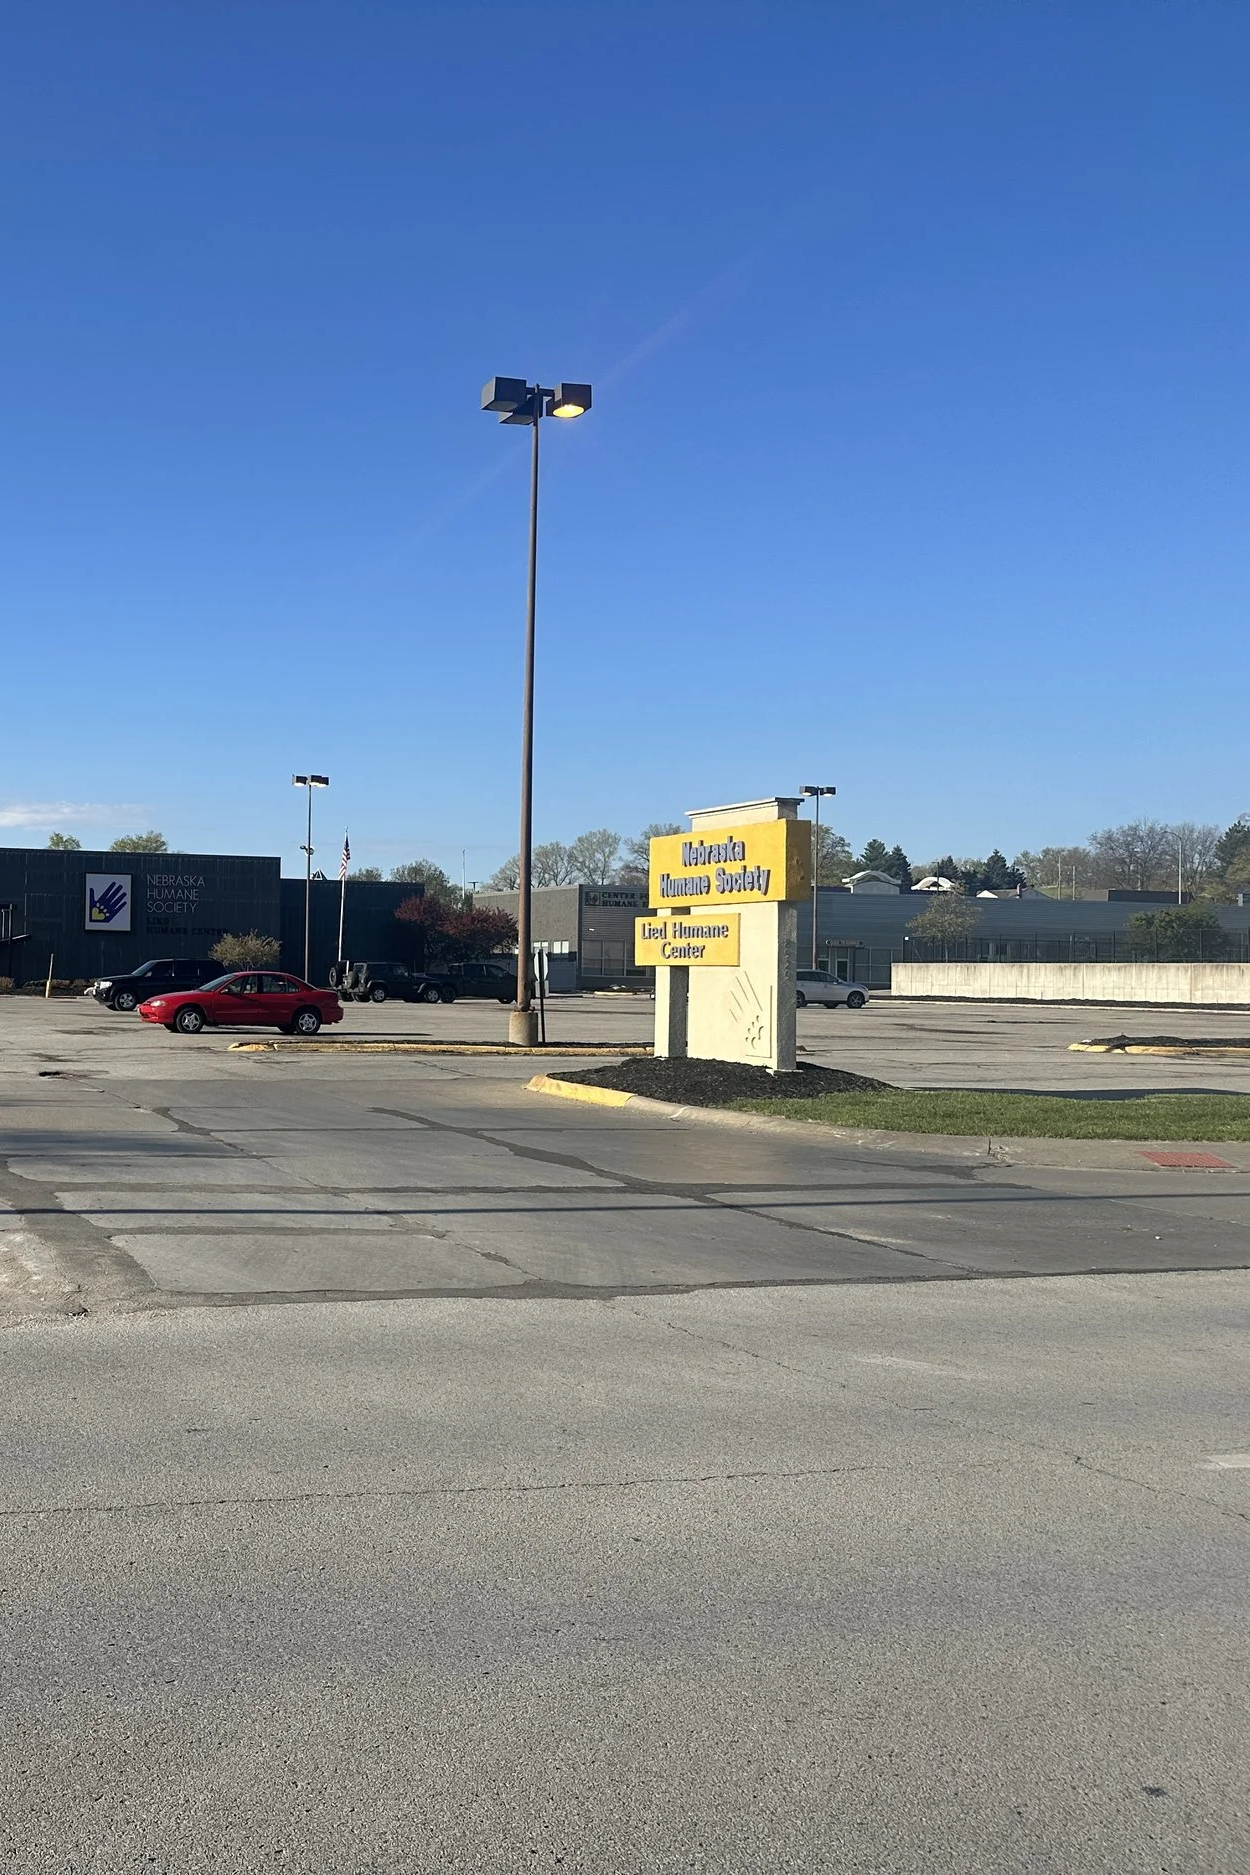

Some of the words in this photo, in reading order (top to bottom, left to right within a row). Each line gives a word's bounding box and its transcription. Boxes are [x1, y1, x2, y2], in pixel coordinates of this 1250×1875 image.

[681, 835, 745, 867] Nebraska
[146, 874, 205, 887] NEBRASKA
[659, 873, 710, 898] Humane
[715, 865, 771, 896] Society
[146, 888, 199, 901] HUMANE
[602, 891, 635, 899] CENTER
[146, 901, 197, 914] SOCIETY
[602, 900, 638, 908] HUMANE
[146, 926, 188, 935] HUMANE
[641, 921, 667, 940] Lied
[672, 921, 729, 940] Humane
[660, 941, 706, 959] Center
